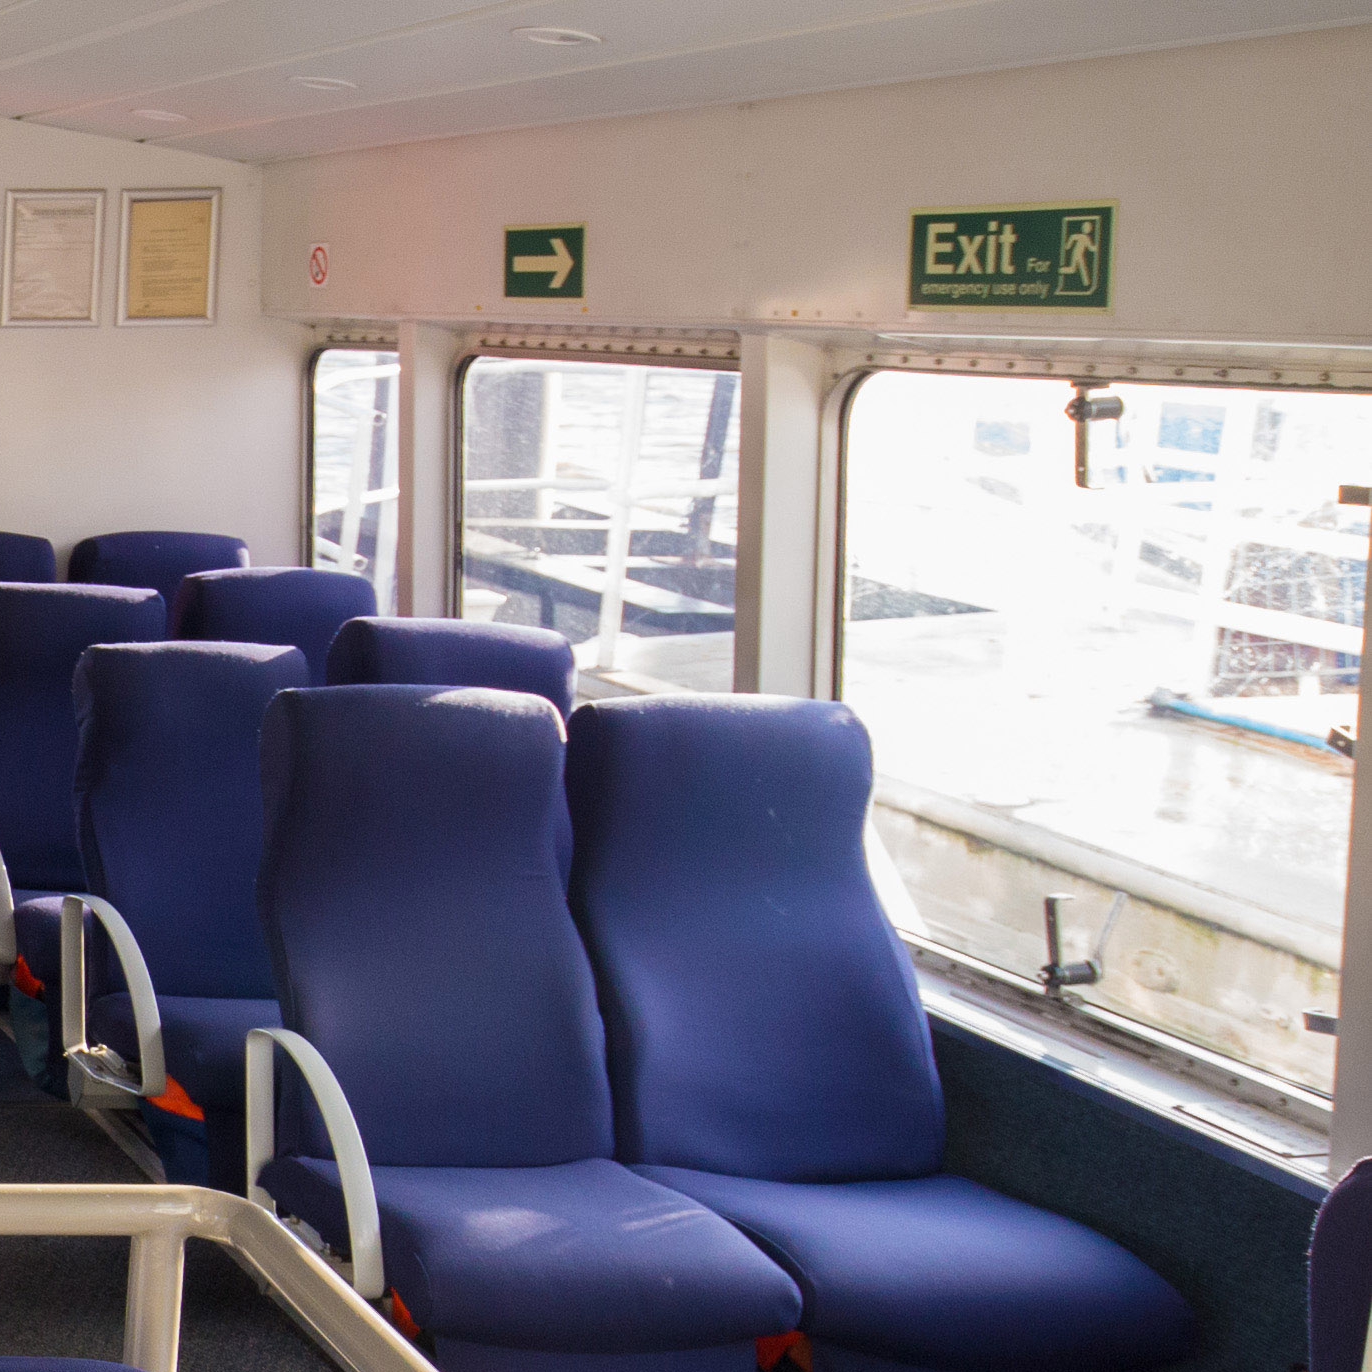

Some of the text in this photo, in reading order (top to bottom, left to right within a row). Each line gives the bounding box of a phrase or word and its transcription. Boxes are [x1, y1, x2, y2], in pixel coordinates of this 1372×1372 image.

[925, 220, 1051, 275] Exit For
[921, 280, 1050, 299] emergency use only
